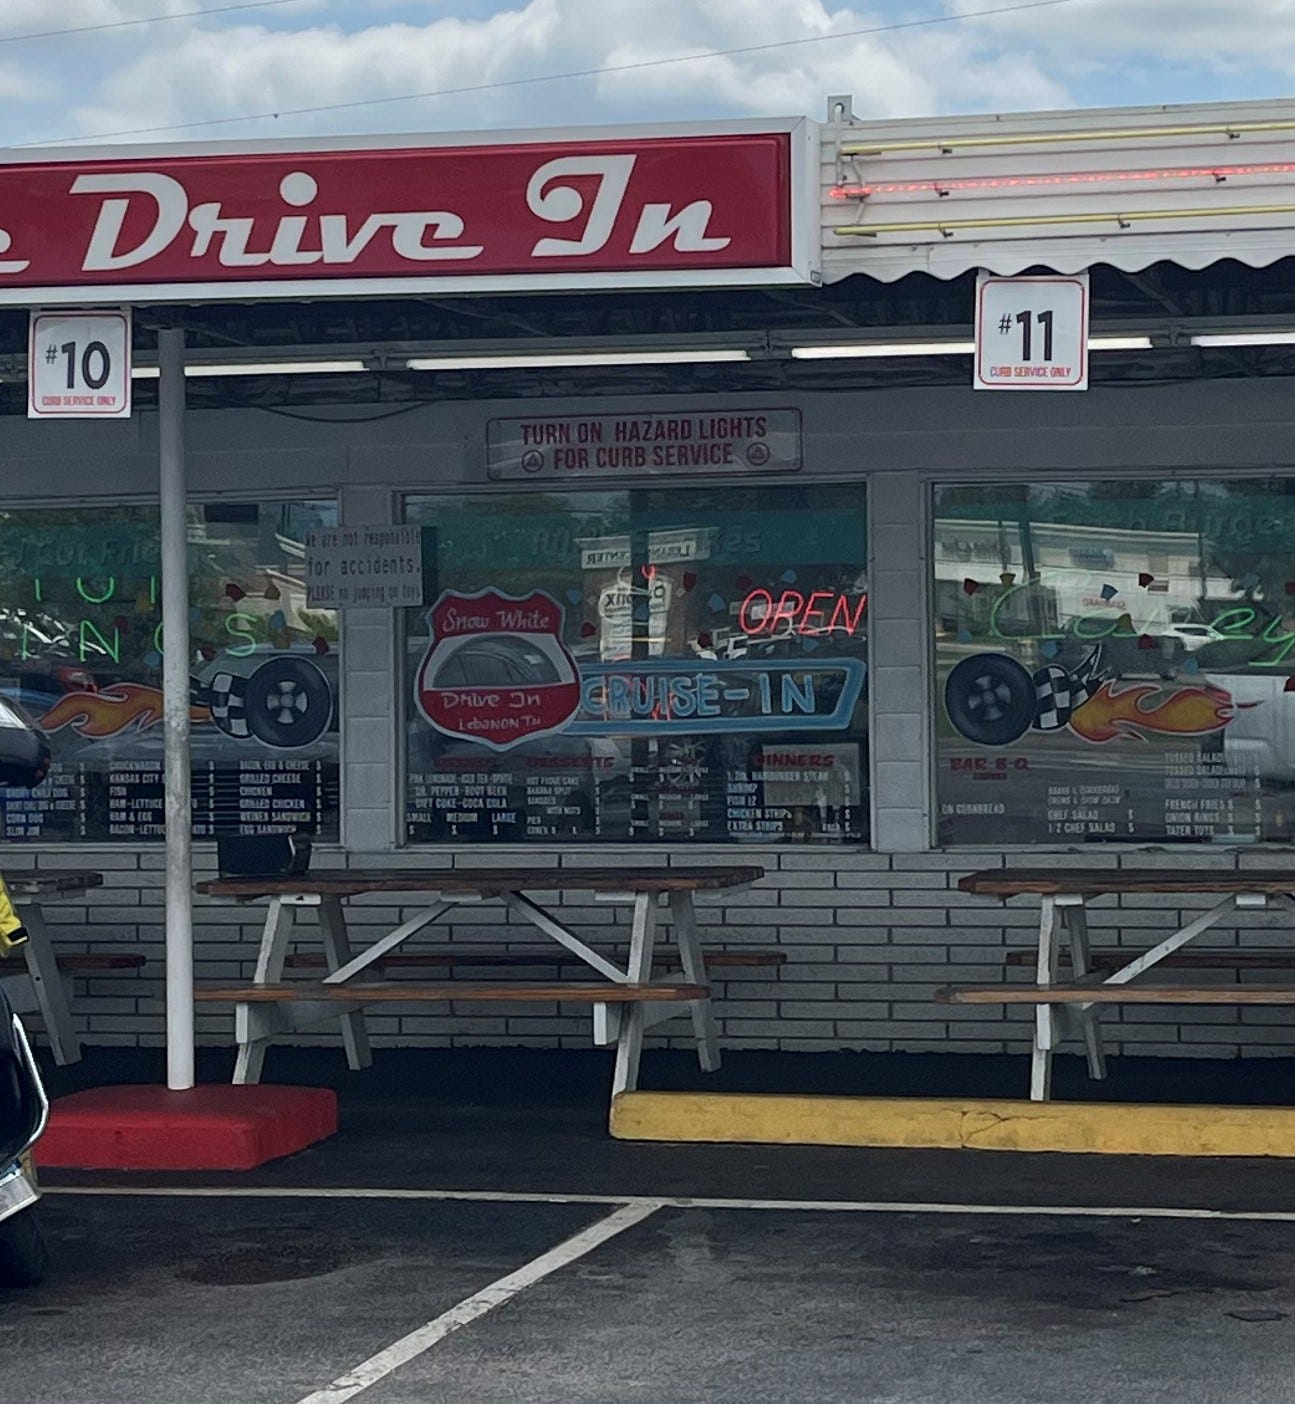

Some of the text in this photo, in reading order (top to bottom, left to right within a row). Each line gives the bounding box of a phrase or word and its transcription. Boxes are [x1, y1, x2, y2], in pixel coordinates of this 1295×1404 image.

[69, 171, 484, 272] Drive
[526, 154, 731, 257] In
[998, 310, 1053, 361] #11
[45, 341, 111, 390] #10
[990, 366, 1071, 377] CURB SERVICE ONLY
[519, 416, 768, 446] TURN ON HAZARD LIGHTS
[553, 442, 733, 470] FOR CURB SERVICE
[323, 532, 337, 547] are
[344, 530, 358, 546] not
[307, 555, 422, 576] for accidents.
[441, 607, 551, 633] Snow White
[739, 588, 868, 636] OPEN
[440, 691, 543, 709] Drive In
[581, 672, 817, 718] CRUISE-IN
[109, 773, 141, 784] KANSAS
[142, 773, 160, 784] CITY
[1164, 799, 1225, 811] FRENCH FRIES
[491, 812, 517, 823] LARGE
[1063, 822, 1117, 833] CHEF SALAD
